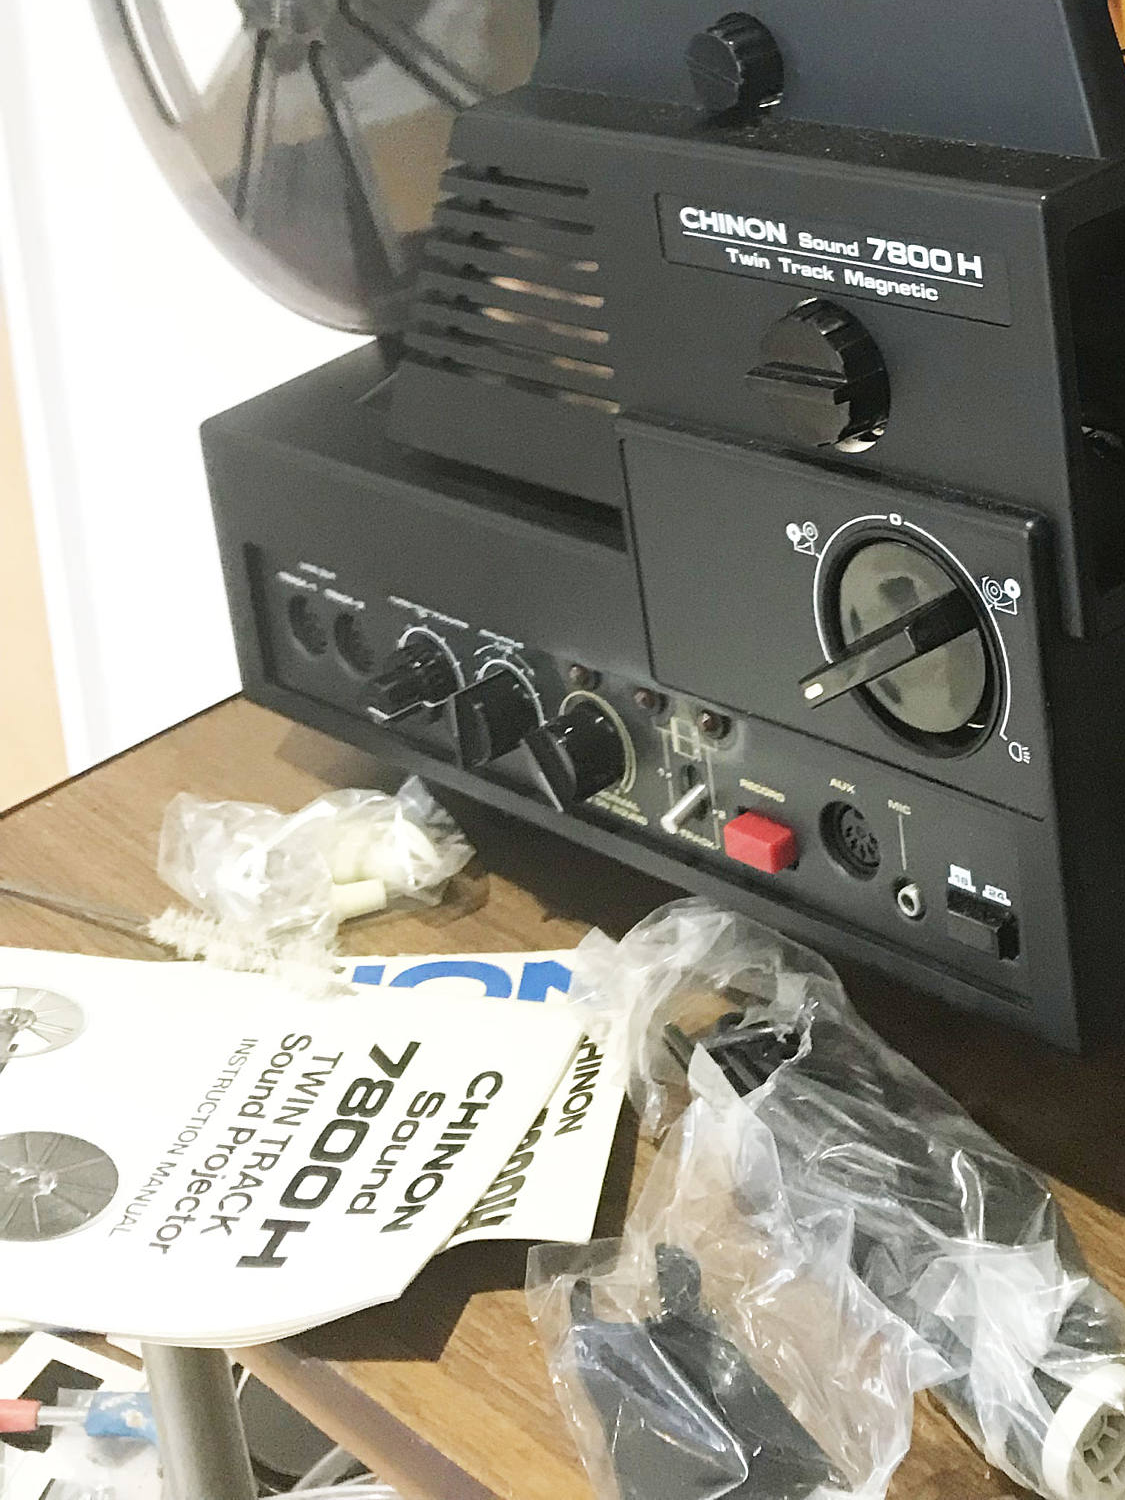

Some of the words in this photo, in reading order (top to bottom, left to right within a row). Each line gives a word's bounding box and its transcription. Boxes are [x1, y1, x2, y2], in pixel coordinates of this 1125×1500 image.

[680, 206, 787, 244] CHINON
[798, 232, 859, 257] Sound
[725, 247, 771, 270] Twin
[778, 256, 834, 282] Track
[844, 268, 939, 301] Magnetic
[887, 799, 912, 816] MIC
[167, 1038, 259, 1157] INSTRUCTION
[237, 1033, 312, 1117] Sound
[273, 1051, 344, 1127] TWIN
[149, 1126, 242, 1254] Projector
[200, 1134, 293, 1236] TRACK
[345, 1091, 446, 1215] Sound
[381, 1071, 503, 1233] CHINON
[108, 1160, 178, 1237] MANUAL
